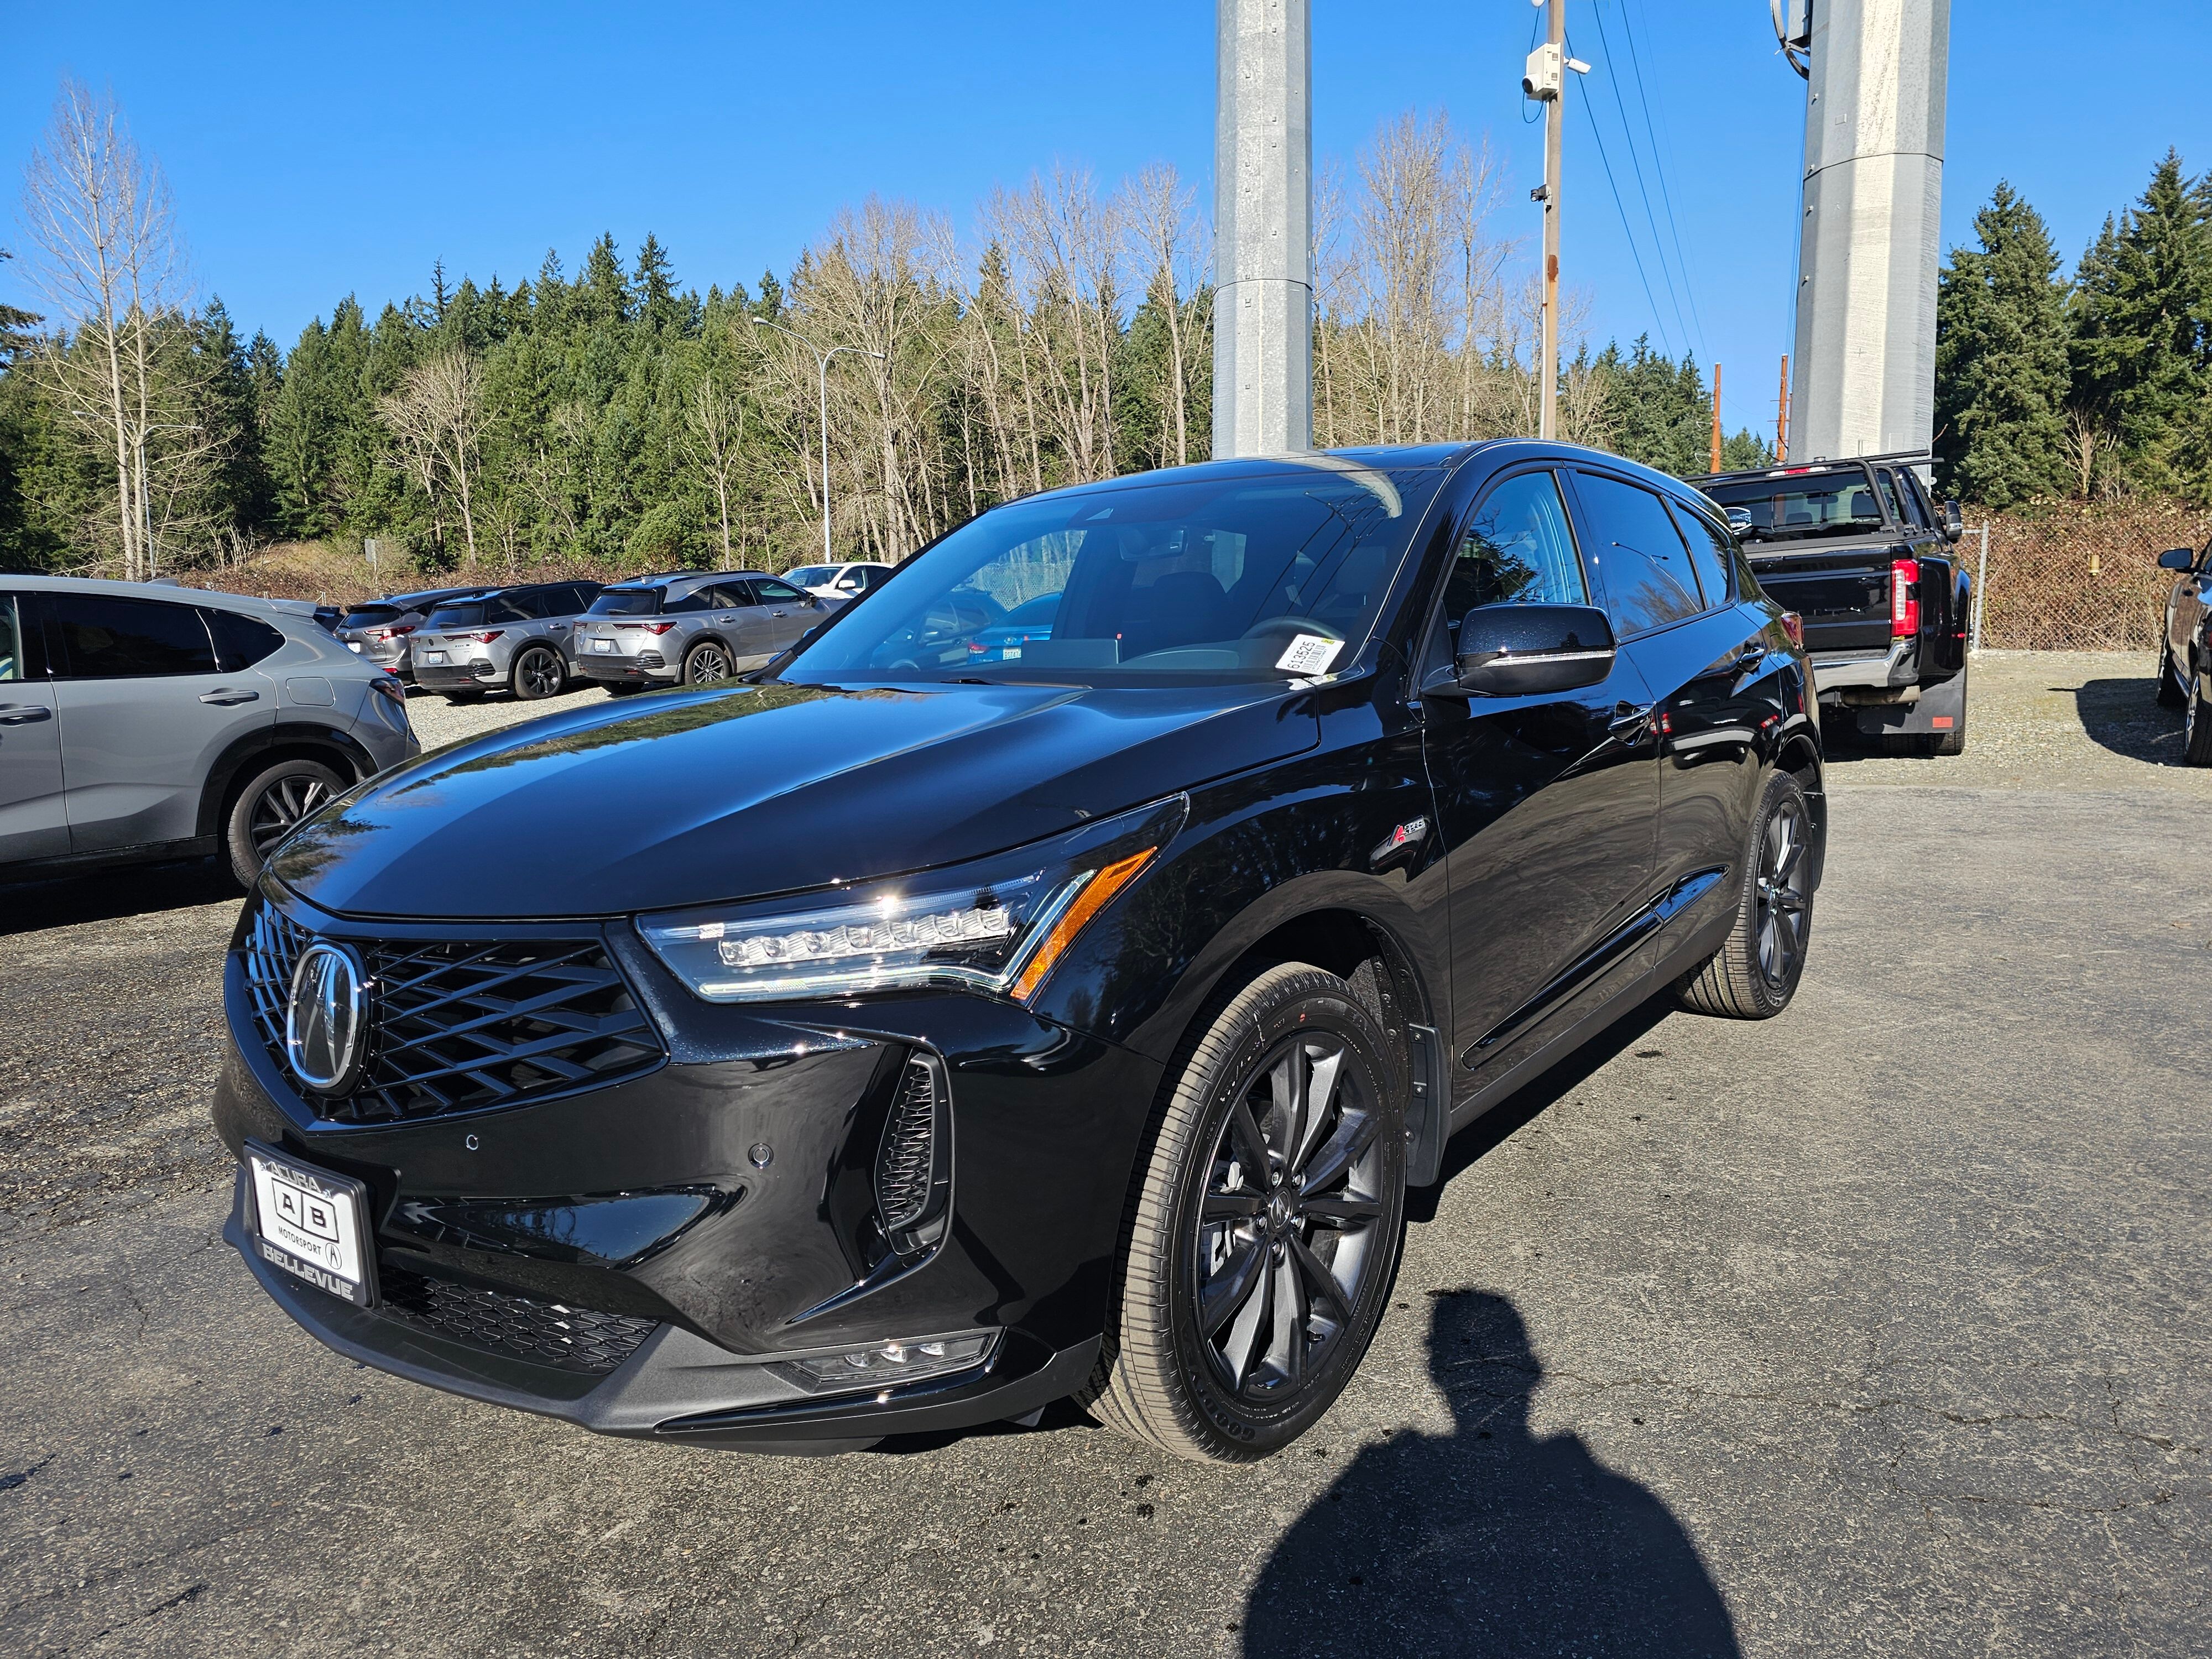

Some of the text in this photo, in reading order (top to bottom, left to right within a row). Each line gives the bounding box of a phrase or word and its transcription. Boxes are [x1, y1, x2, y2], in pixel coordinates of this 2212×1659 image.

[1287, 641, 1316, 669] 613525
[269, 1161, 321, 1193] ACURA
[283, 1192, 327, 1228] A B
[278, 1225, 322, 1256] MOTORSPORT
[262, 1243, 353, 1301] BELLEVUE
